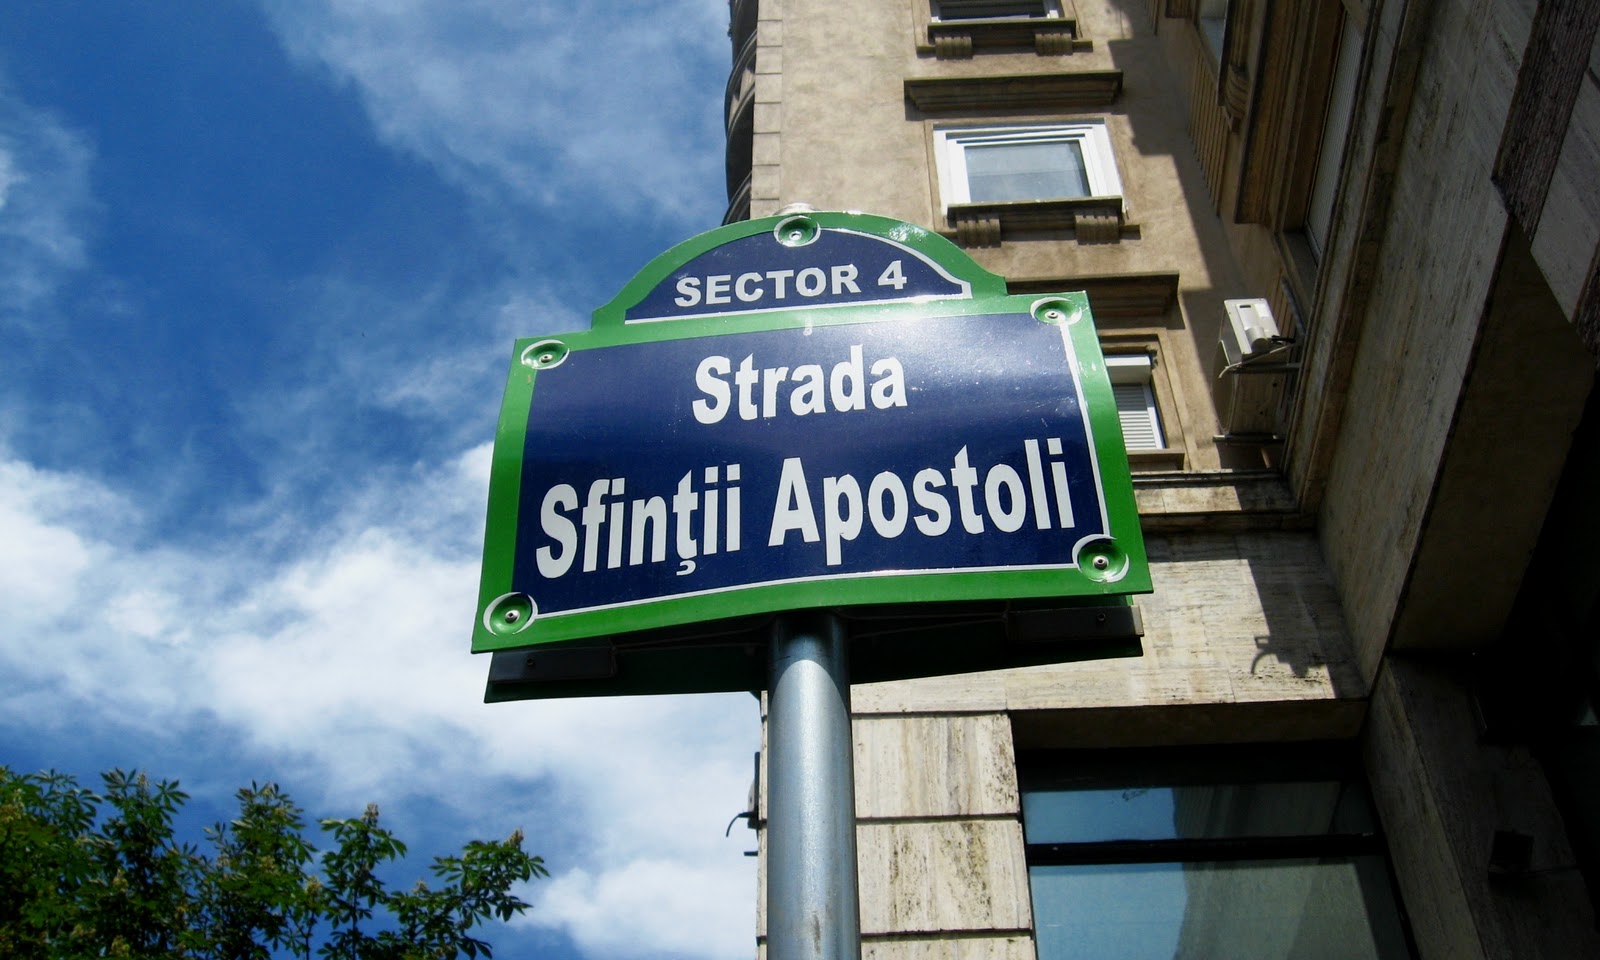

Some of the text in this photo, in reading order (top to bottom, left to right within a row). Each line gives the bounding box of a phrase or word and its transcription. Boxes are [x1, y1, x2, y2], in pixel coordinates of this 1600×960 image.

[674, 259, 908, 307] SECTOR 4
[691, 344, 908, 425] Strada
[768, 437, 1075, 567] Apostoli
